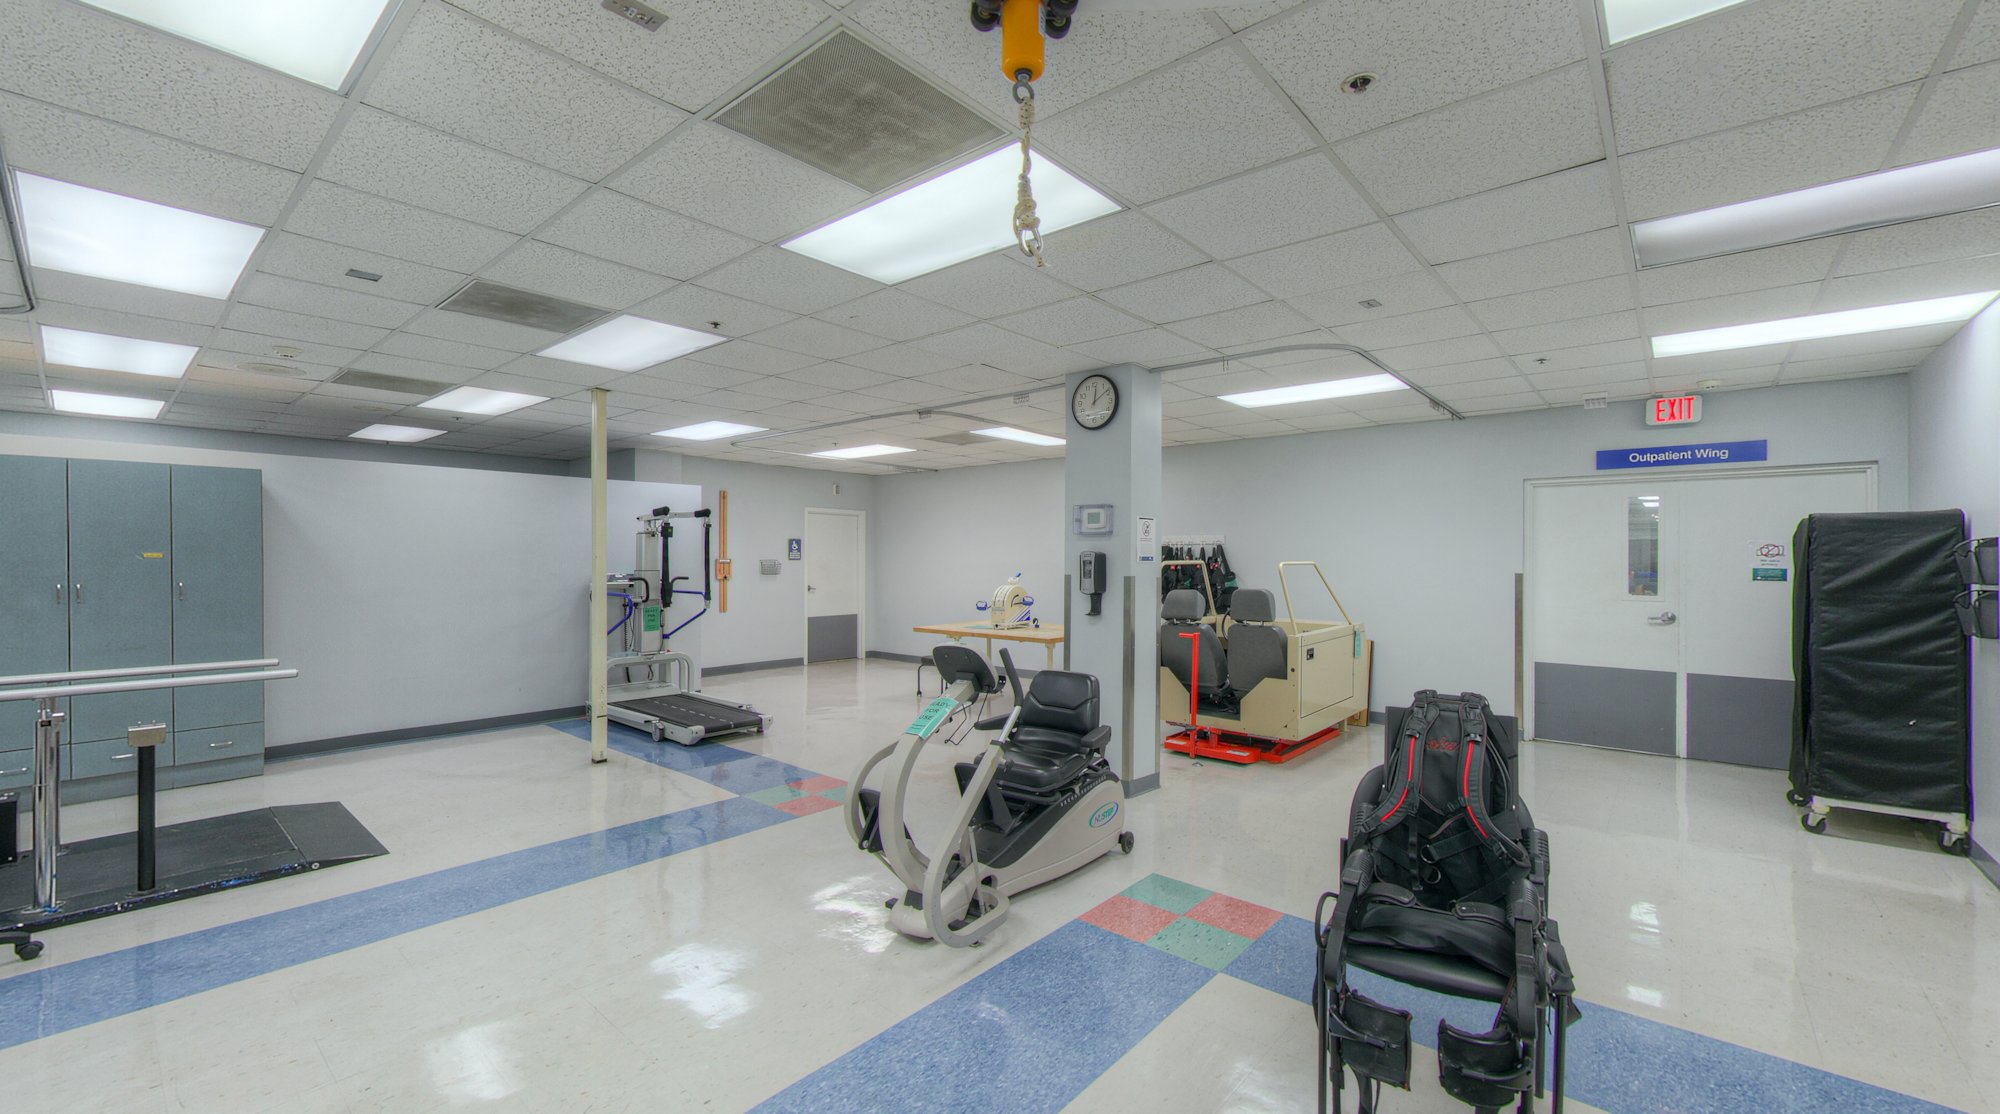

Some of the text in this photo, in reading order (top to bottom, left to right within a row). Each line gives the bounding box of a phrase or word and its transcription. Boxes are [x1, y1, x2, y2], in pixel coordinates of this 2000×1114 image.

[1655, 396, 1695, 422] EXIT
[1629, 448, 1728, 464] Outpatient Wing
